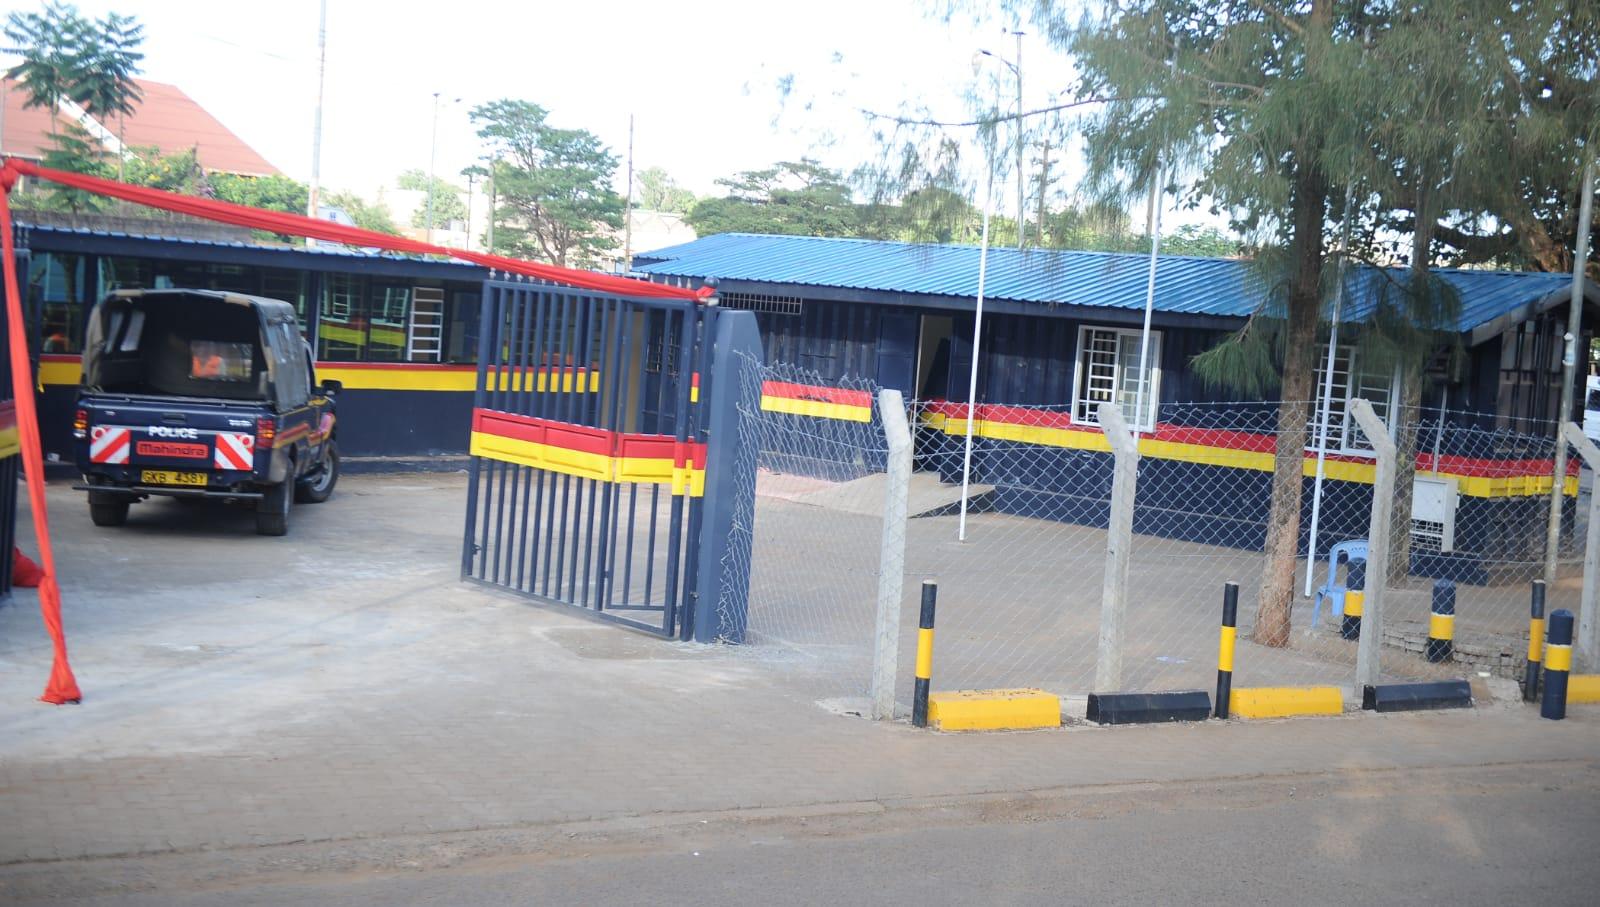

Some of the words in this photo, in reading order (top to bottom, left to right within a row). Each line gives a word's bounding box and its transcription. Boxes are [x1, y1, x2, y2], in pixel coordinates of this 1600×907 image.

[148, 426, 198, 439] POLICE
[143, 471, 167, 483] GKB
[175, 472, 204, 485] 438Y
